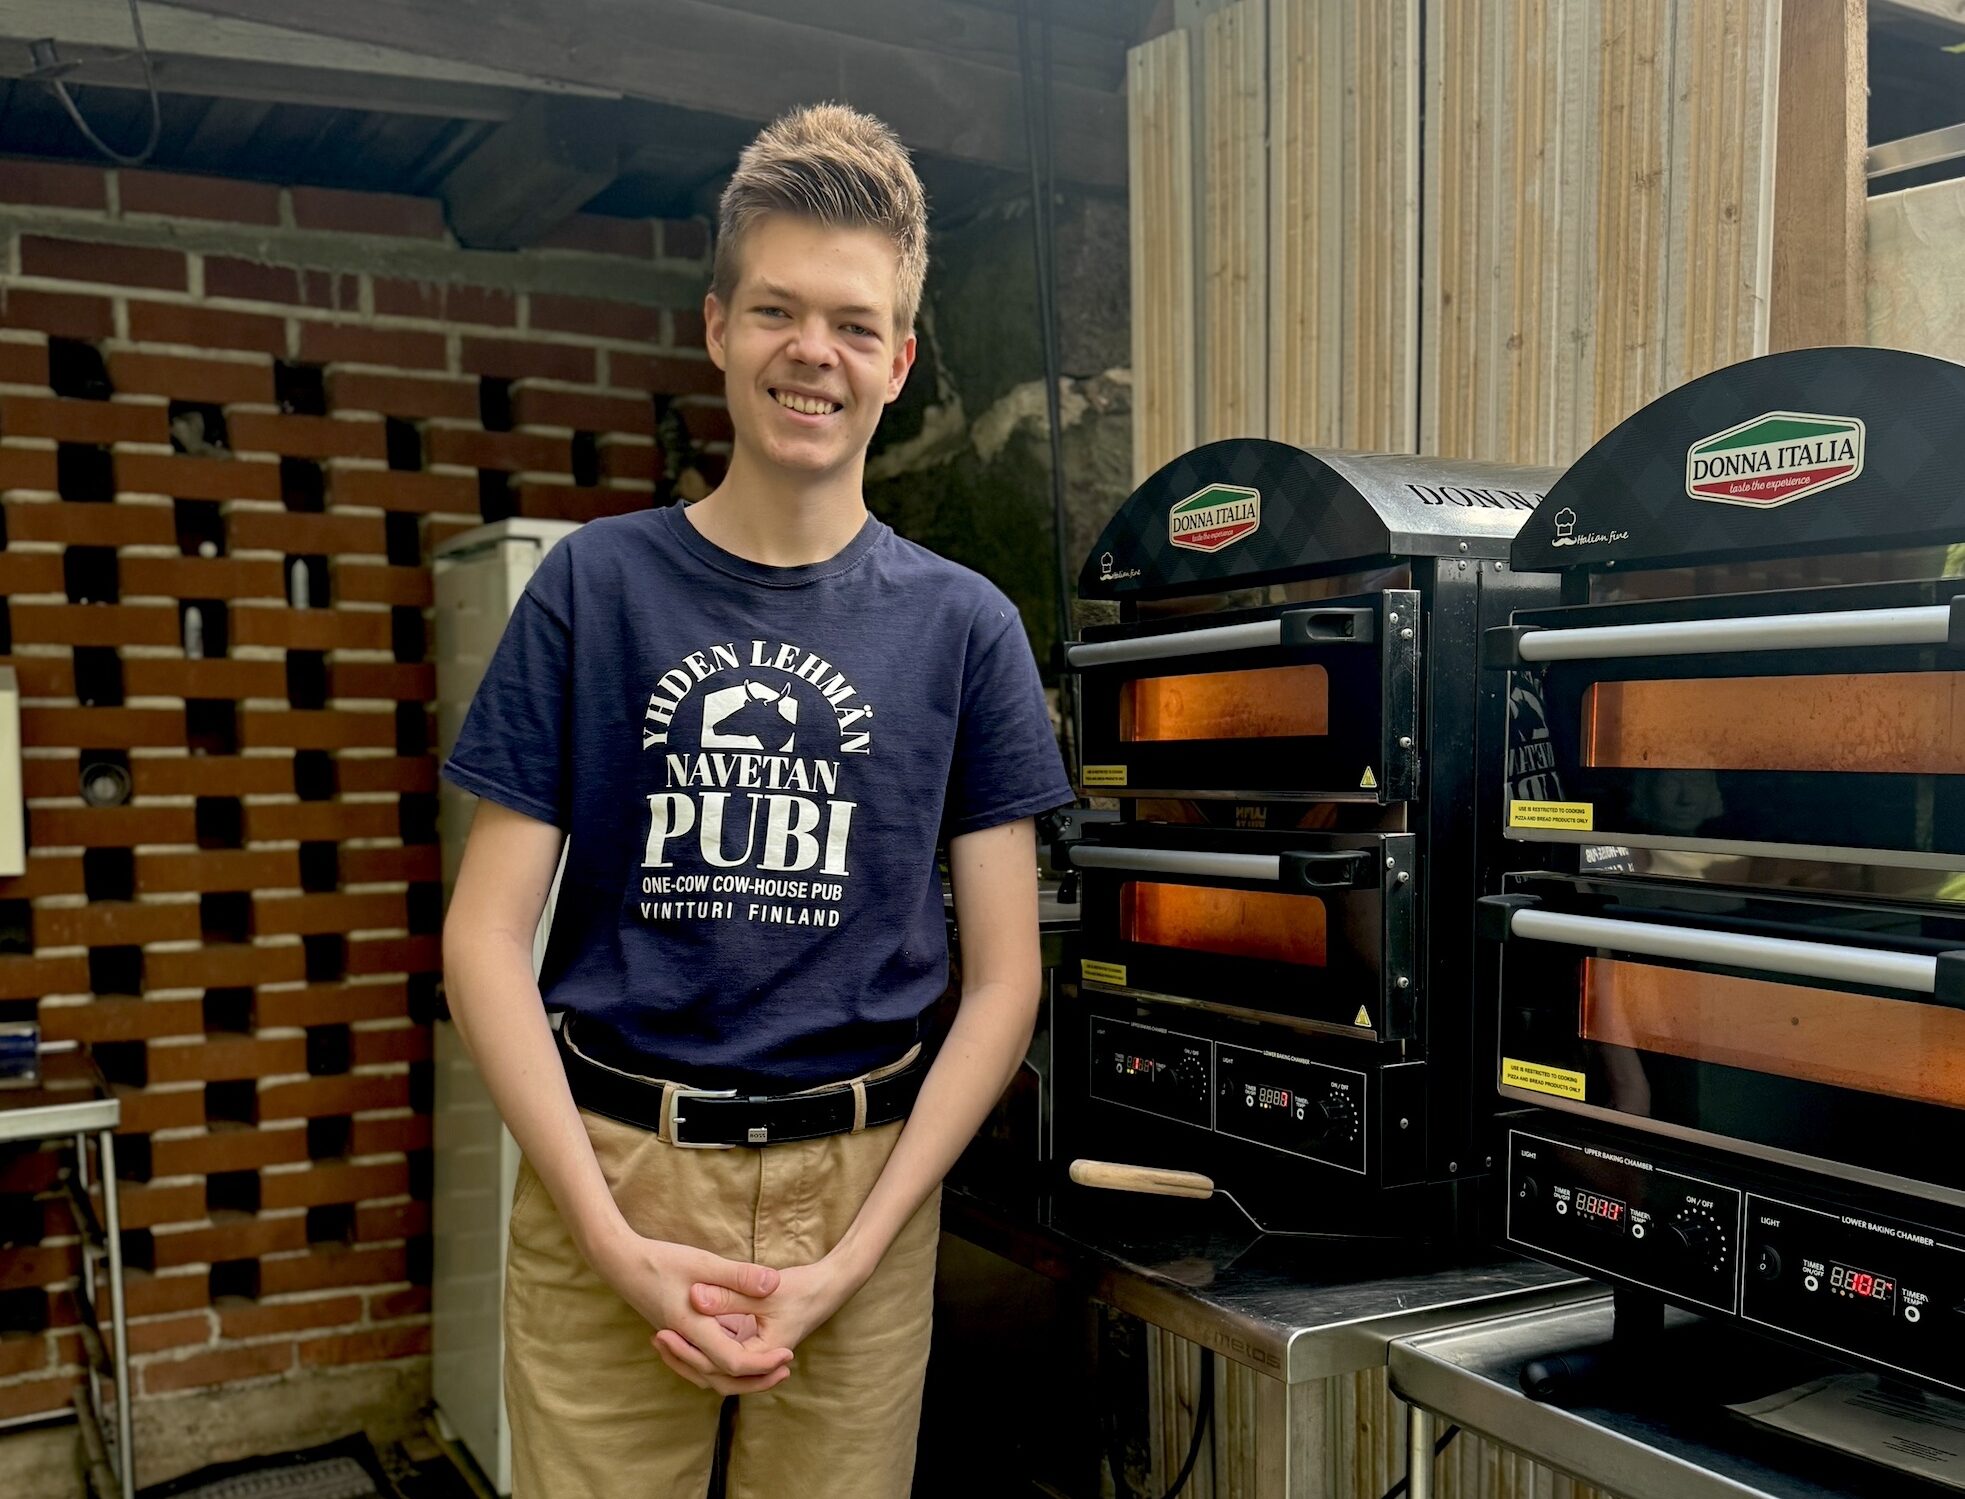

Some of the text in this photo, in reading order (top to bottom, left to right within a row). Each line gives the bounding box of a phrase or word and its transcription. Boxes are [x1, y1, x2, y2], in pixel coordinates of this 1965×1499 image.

[1692, 438, 1856, 481] DONNA ITALIA
[1405, 483, 1544, 511] DONN
[1729, 476, 1811, 494] taste the experience
[1173, 502, 1256, 533] DONNA ITALIA
[1577, 532, 1608, 545] Italian
[643, 640, 874, 755] YHDEN LEHMÄN
[665, 752, 840, 795] NAVETAN
[640, 791, 858, 877] PUBI
[642, 875, 843, 901] ONE-COW COW-HOUSE PUB
[640, 901, 840, 928] VINTTURI FINLAND
[1521, 1150, 1537, 1160] LIGHT
[1584, 1147, 1654, 1172] UPPER BAKING CHAMBER
[1553, 1185, 1571, 1197] TIMER
[1686, 1195, 1696, 1204] ON
[1701, 1200, 1714, 1209] OFF
[1760, 1216, 1781, 1228] LIGHT
[1841, 1215, 1935, 1247] LOWER BAKING CHAMBER
[1802, 1258, 1825, 1272] TIMER
[1802, 1266, 1825, 1278] ON/OFF
